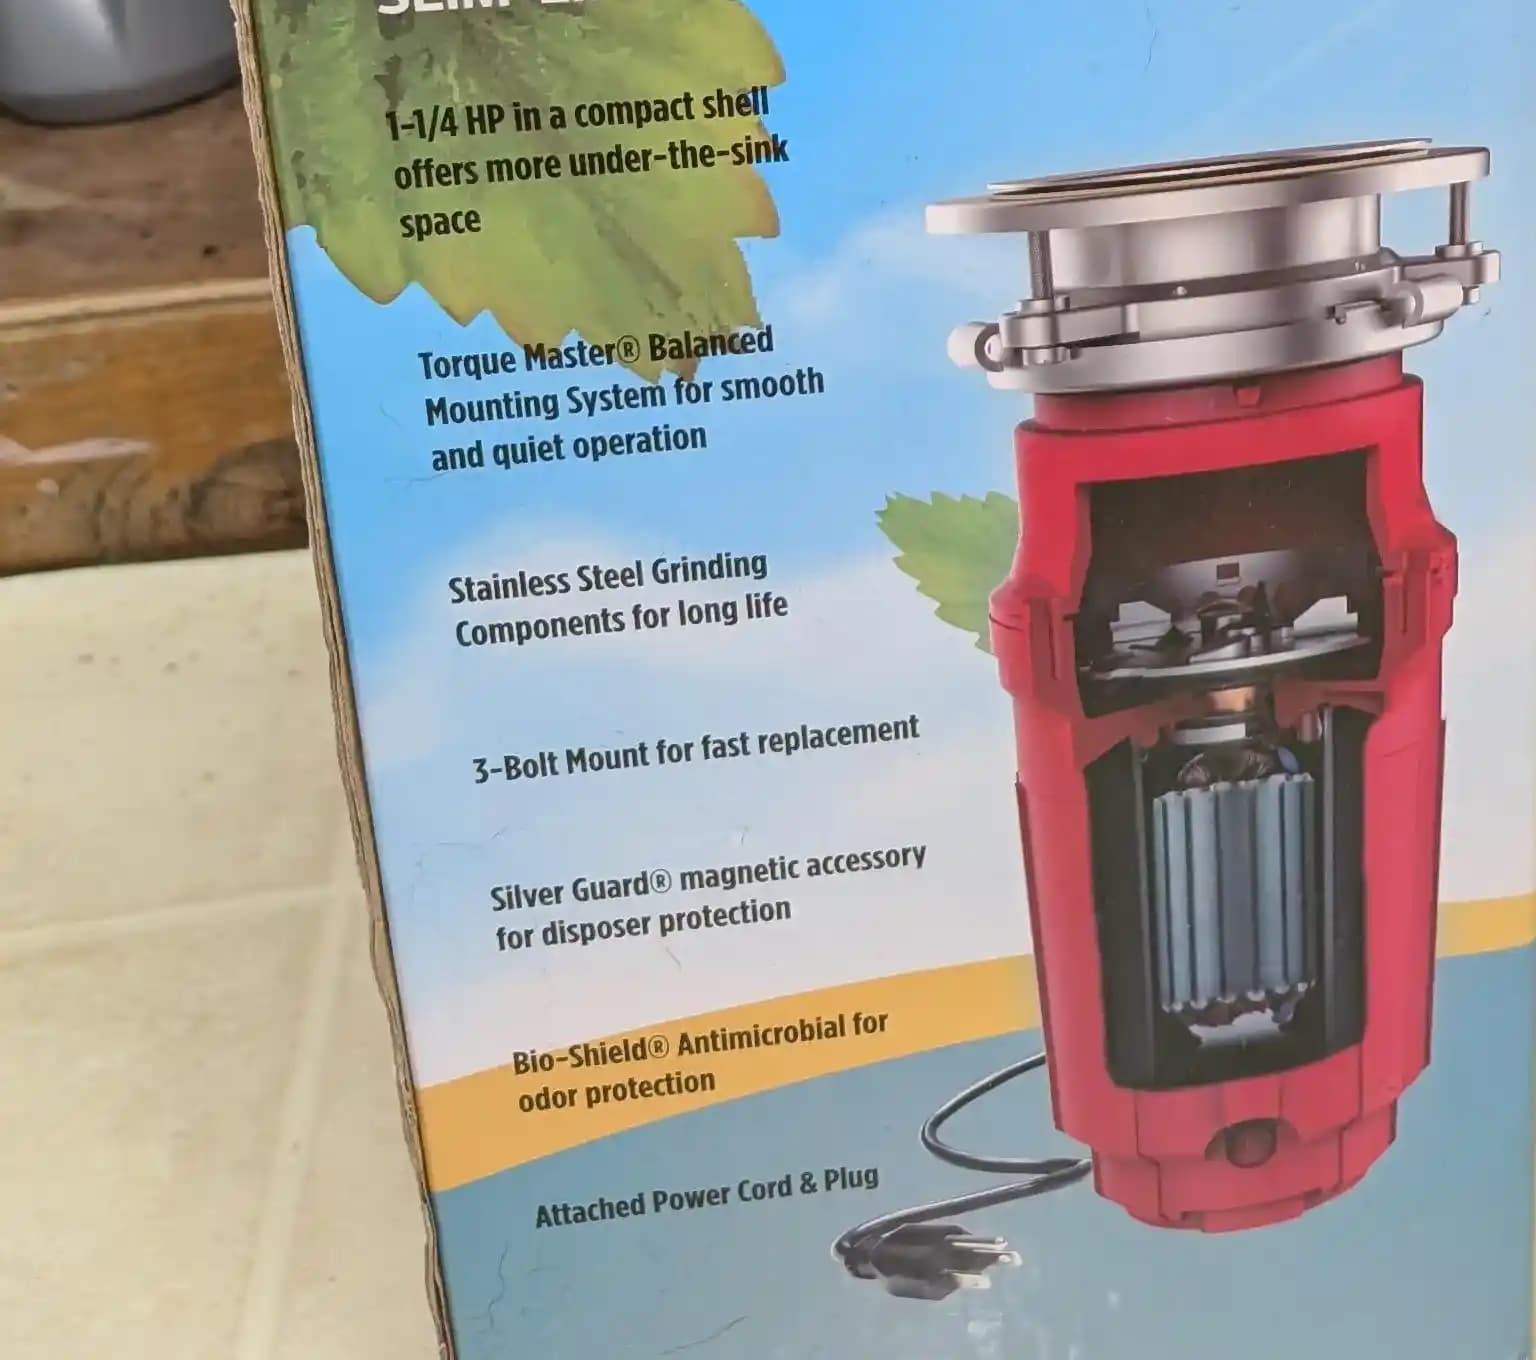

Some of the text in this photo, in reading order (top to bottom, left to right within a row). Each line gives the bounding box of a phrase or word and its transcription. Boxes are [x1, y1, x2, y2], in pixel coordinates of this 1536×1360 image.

[385, 85, 770, 143] 1-1/4 HP in a compact shell
[394, 133, 790, 189] offers more under-the-sink
[400, 208, 482, 241] space
[418, 324, 775, 381] Torque Master® Balanced
[424, 367, 825, 426] Mounting System for smooth
[431, 424, 707, 471] and quiet operation
[448, 551, 768, 605] Stainless Steel Grinding
[456, 591, 789, 647] Components for long life
[472, 713, 921, 784] 3-Bolt Mount for fast replacement
[490, 843, 928, 912] Silver Guard® magnetic accessory
[497, 896, 792, 951] for disposer protection
[512, 1011, 889, 1075] Bio-Shield® Antimicrobial for
[518, 1072, 717, 1113] odor protection
[535, 1163, 880, 1229] Attached Power Cord & Plug
